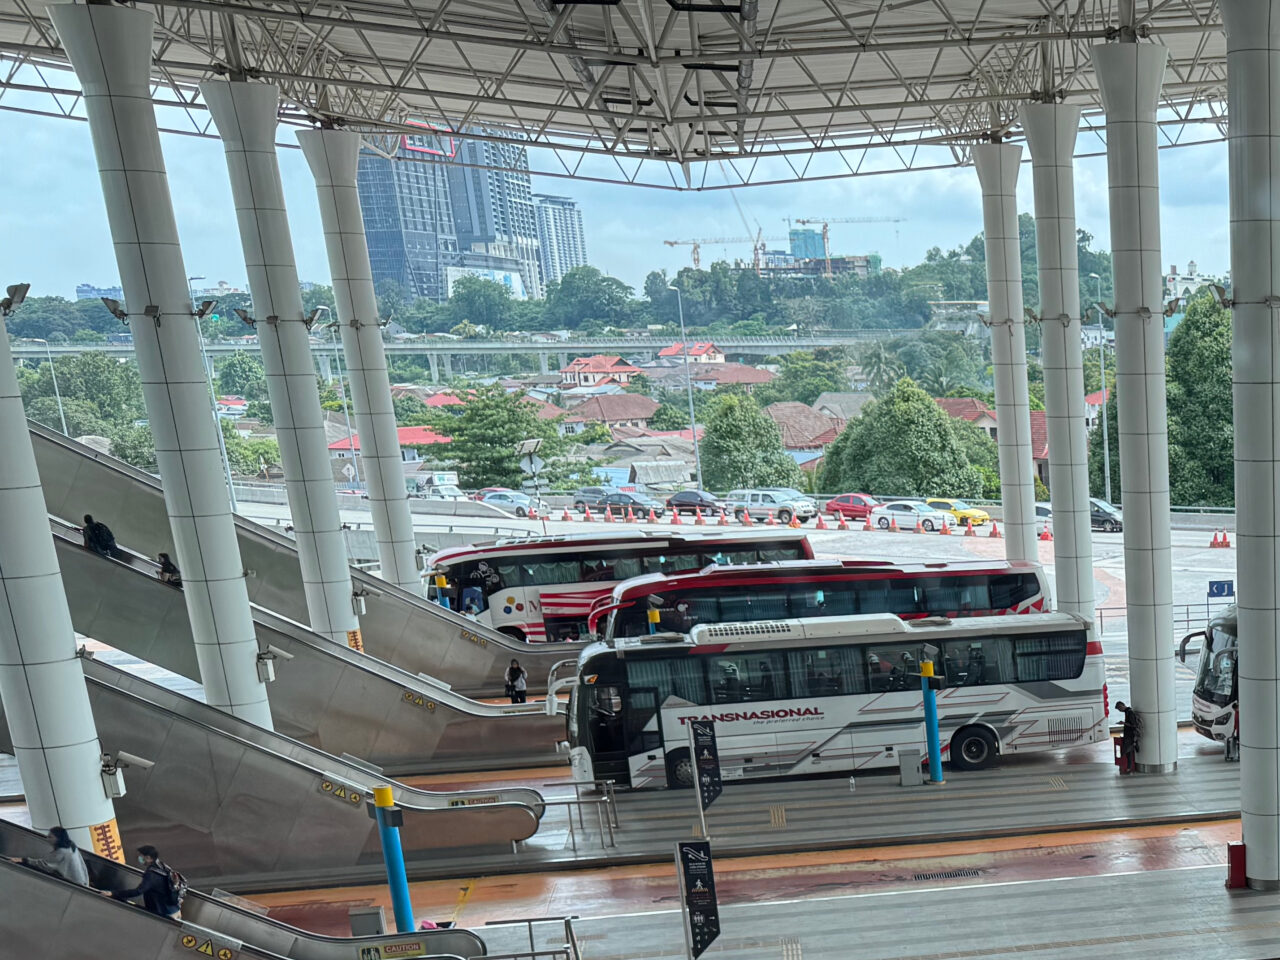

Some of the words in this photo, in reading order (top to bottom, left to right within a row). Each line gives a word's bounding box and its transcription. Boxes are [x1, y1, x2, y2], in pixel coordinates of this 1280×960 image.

[1222, 584, 1228, 596] J
[766, 717, 801, 725] preferred
[386, 943, 419, 952] CAUTION
